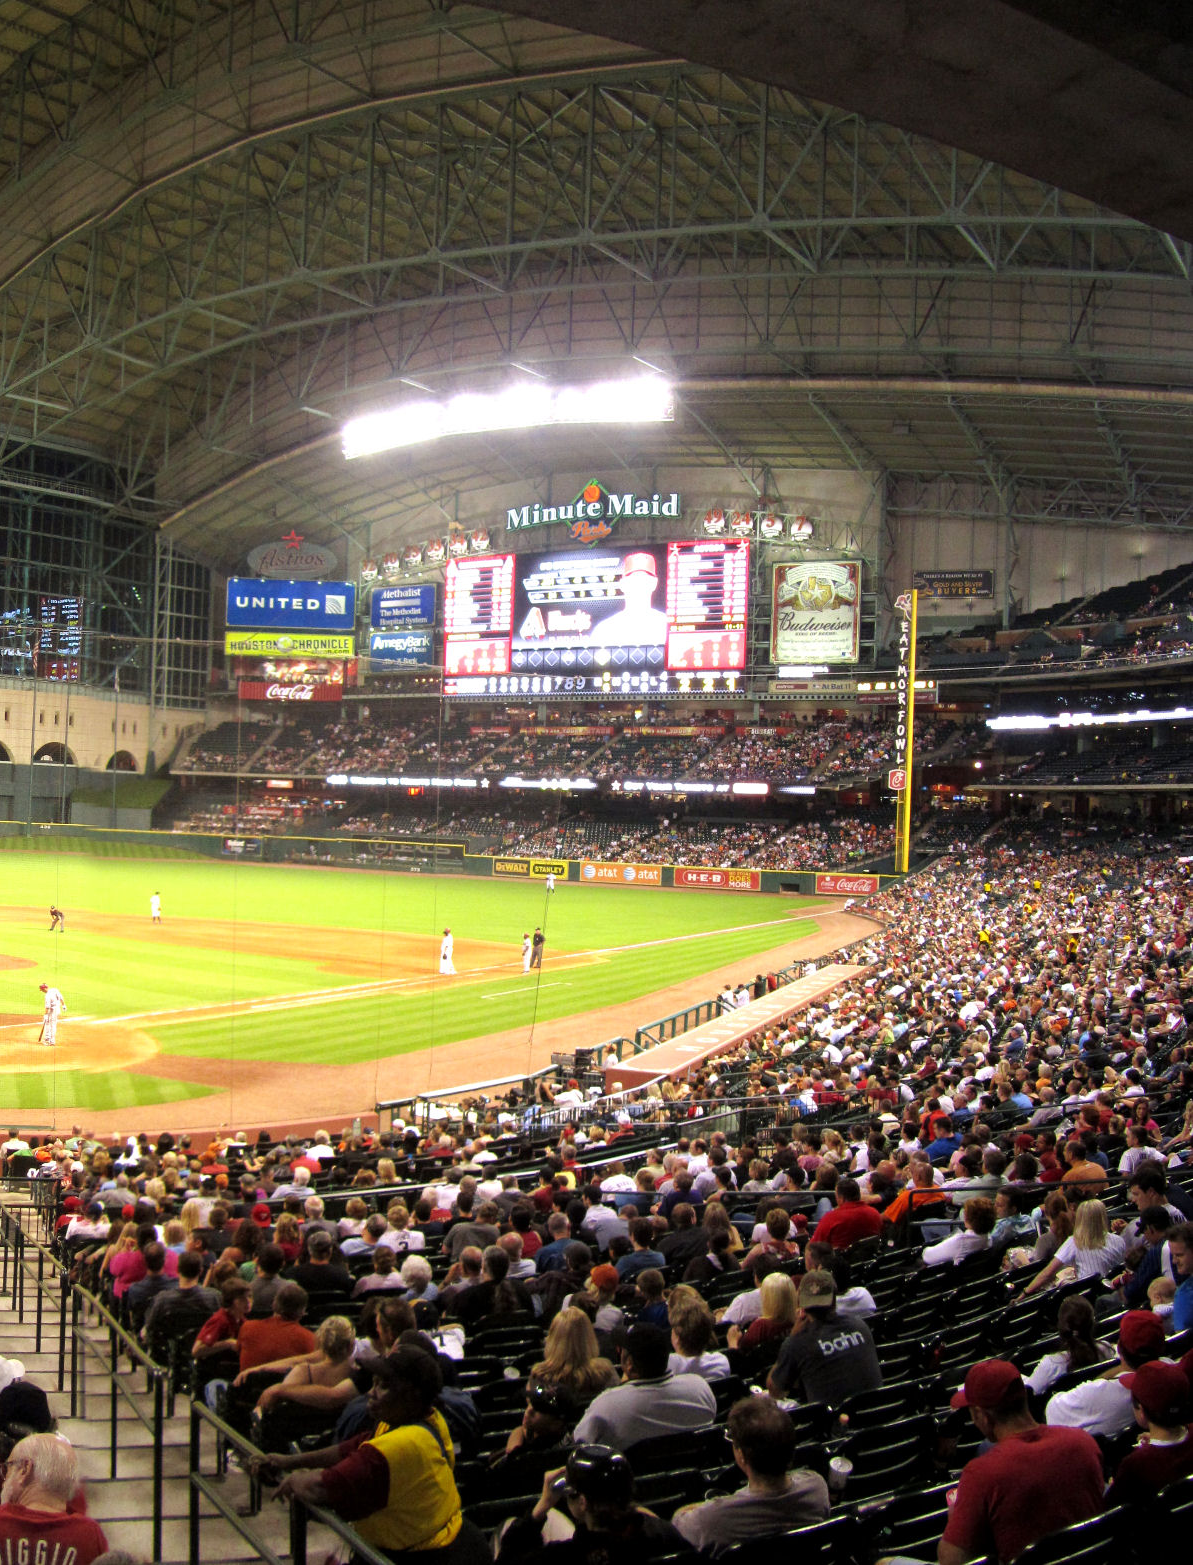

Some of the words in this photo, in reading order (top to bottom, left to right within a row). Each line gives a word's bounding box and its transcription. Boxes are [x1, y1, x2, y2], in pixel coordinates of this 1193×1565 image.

[506, 500, 602, 531] Minute
[607, 493, 680, 517] Maid
[732, 511, 750, 526] 24
[765, 514, 775, 528] 5
[795, 516, 807, 531] 7
[381, 588, 421, 600] Methodist
[937, 587, 977, 595] BUYERS
[235, 595, 320, 610] UNITED
[392, 607, 422, 615] Methodist
[778, 610, 853, 632] Budweiser
[230, 639, 280, 651] HOUSTON
[292, 639, 350, 650] CHRONICLE
[373, 635, 431, 651] AmegyBank
[899, 621, 909, 661] EAT
[897, 665, 908, 705] MOR
[895, 710, 906, 765] FOWL
[534, 865, 563, 874] STANLEY
[597, 866, 618, 878] at&t
[638, 869, 659, 880] at&t
[687, 873, 722, 883] H-E-B
[728, 881, 752, 889] MORE
[817, 1331, 865, 1357] bahn
